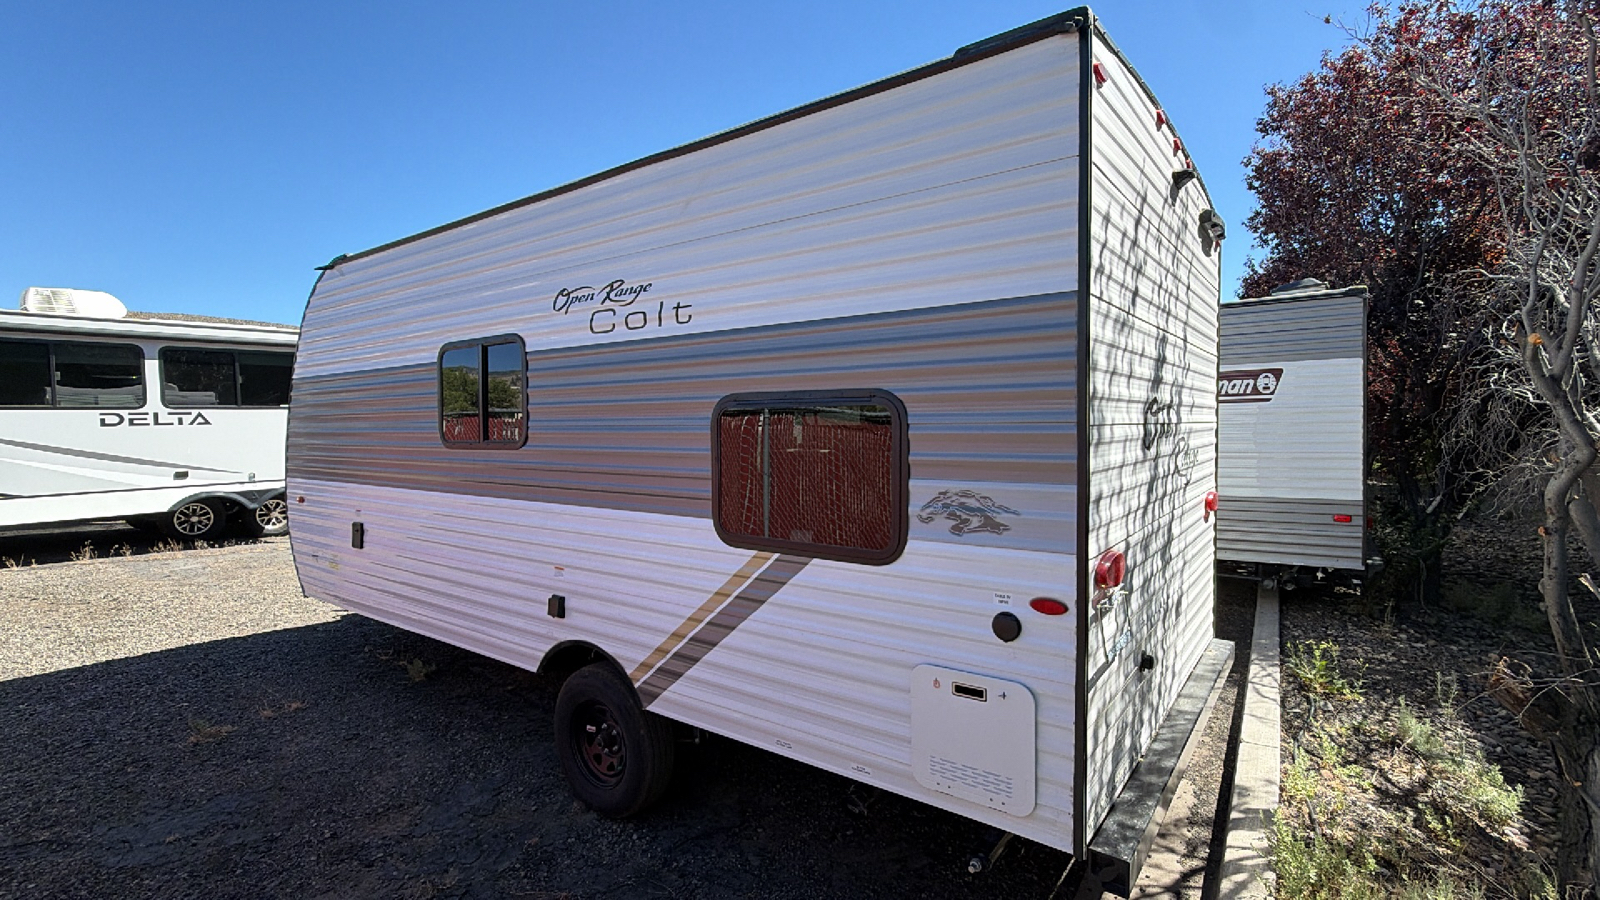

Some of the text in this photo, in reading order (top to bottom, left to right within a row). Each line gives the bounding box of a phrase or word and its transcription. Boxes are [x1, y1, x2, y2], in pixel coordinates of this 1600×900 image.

[552, 279, 653, 315] Open Range
[589, 301, 692, 334] Colt
[99, 411, 213, 427] DELTA
